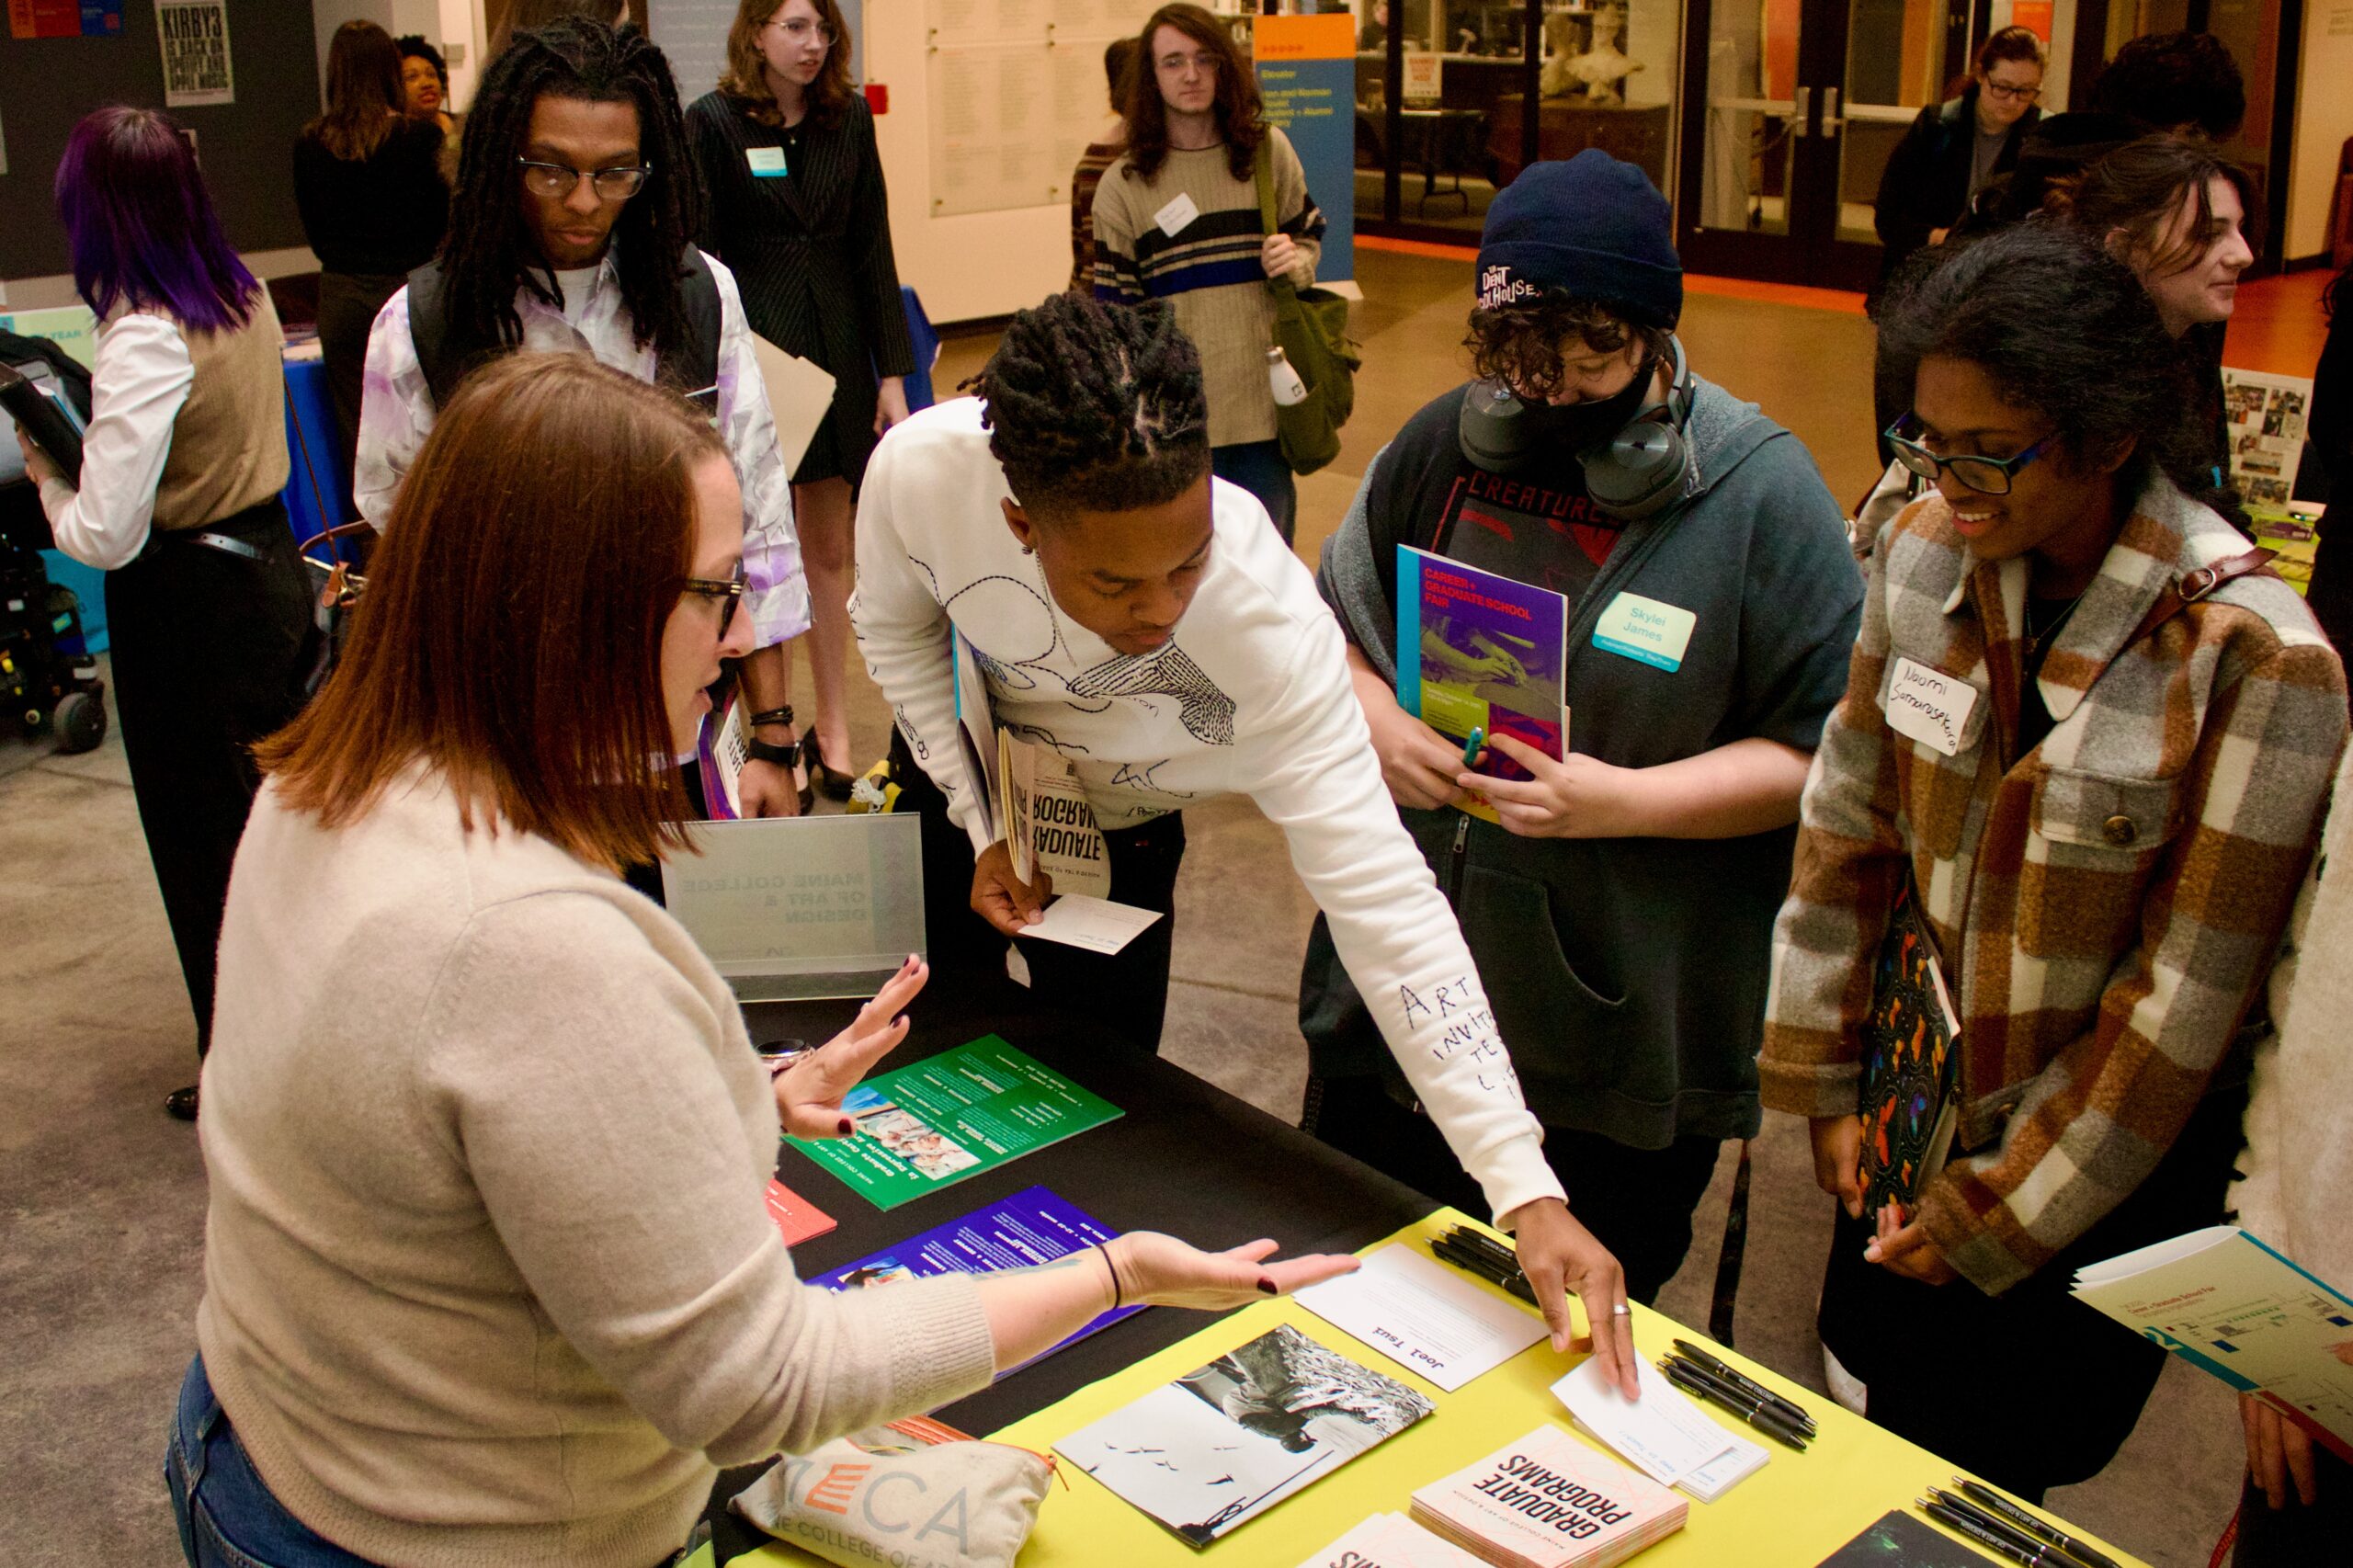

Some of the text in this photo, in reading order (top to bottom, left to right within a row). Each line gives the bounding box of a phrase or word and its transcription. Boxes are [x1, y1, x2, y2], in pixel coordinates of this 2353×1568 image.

[161, 6, 222, 39] KIRBY3
[1483, 267, 1511, 290] DENT
[1425, 567, 1468, 589] CAREER
[1425, 580, 1533, 622] GRADUATE SCHOOL
[1426, 593, 1449, 608] FAIR
[1622, 622, 1663, 642] James
[1904, 665, 1949, 696] Naomi
[1400, 976, 1470, 1030] ART
[1432, 1009, 1493, 1061] INVIT
[835, 1136, 861, 1153] Certi
[834, 1156, 858, 1173] COLLEGE
[858, 1152, 896, 1177] Graduate
[863, 1142, 910, 1172] Expressive
[855, 1172, 874, 1184] MAINE
[904, 1171, 920, 1180] in
[1036, 1210, 1059, 1223] months
[1077, 1221, 1111, 1243] .MECA.EDU
[950, 1237, 979, 1255] SUPPORT
[980, 1257, 1004, 1271] RTISE
[1369, 1326, 1407, 1348] Tsui
[1406, 1347, 1446, 1370] Joel
[1752, 1384, 1776, 1402] COLLEGE
[1498, 1454, 1633, 1526] PROGRAMS
[1473, 1472, 1600, 1540] GRADUATE
[1482, 1507, 1498, 1516] ART
[1508, 1520, 1540, 1537] COLLEGE
[1959, 1520, 1982, 1535] DESIGN
[2018, 1514, 2030, 1523] ART
[797, 1521, 885, 1564] COLLEGE
[1985, 1534, 1997, 1544] ART
